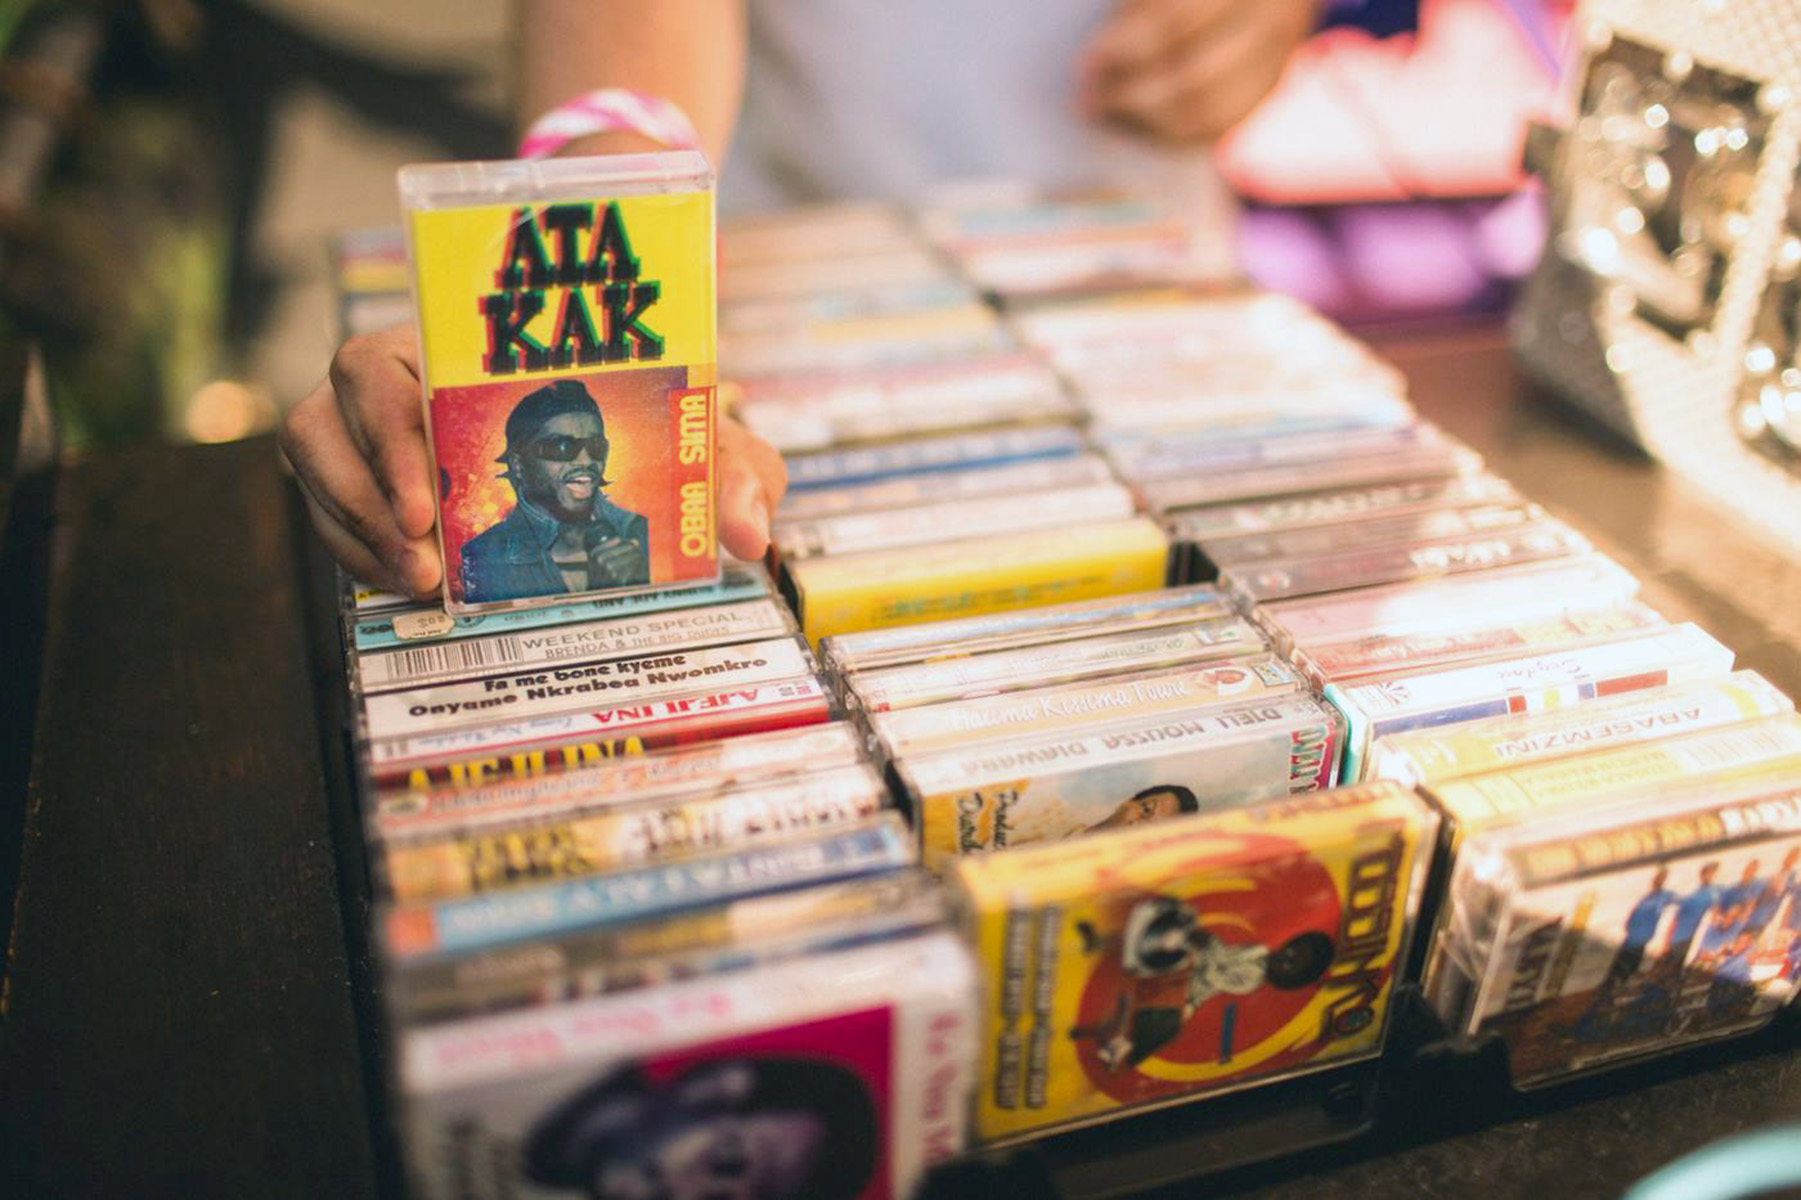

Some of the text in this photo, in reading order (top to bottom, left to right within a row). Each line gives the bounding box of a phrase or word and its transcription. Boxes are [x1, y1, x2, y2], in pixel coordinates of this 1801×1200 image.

[494, 202, 640, 290] ATA
[477, 281, 664, 375] KAK
[679, 393, 706, 465] SIMA
[523, 610, 738, 650] WEEKEND SPECIAL
[545, 640, 609, 658] BRENDA
[615, 638, 626, 649] &
[632, 635, 654, 647] THE
[410, 657, 766, 718] Onyame Nkrabea Nwomkro
[484, 655, 685, 692] Fa me bone kyeme
[1104, 720, 1204, 749] MOUSSA
[1496, 707, 1701, 756] ABASEMZINI
[960, 740, 1087, 776] DIAWARA
